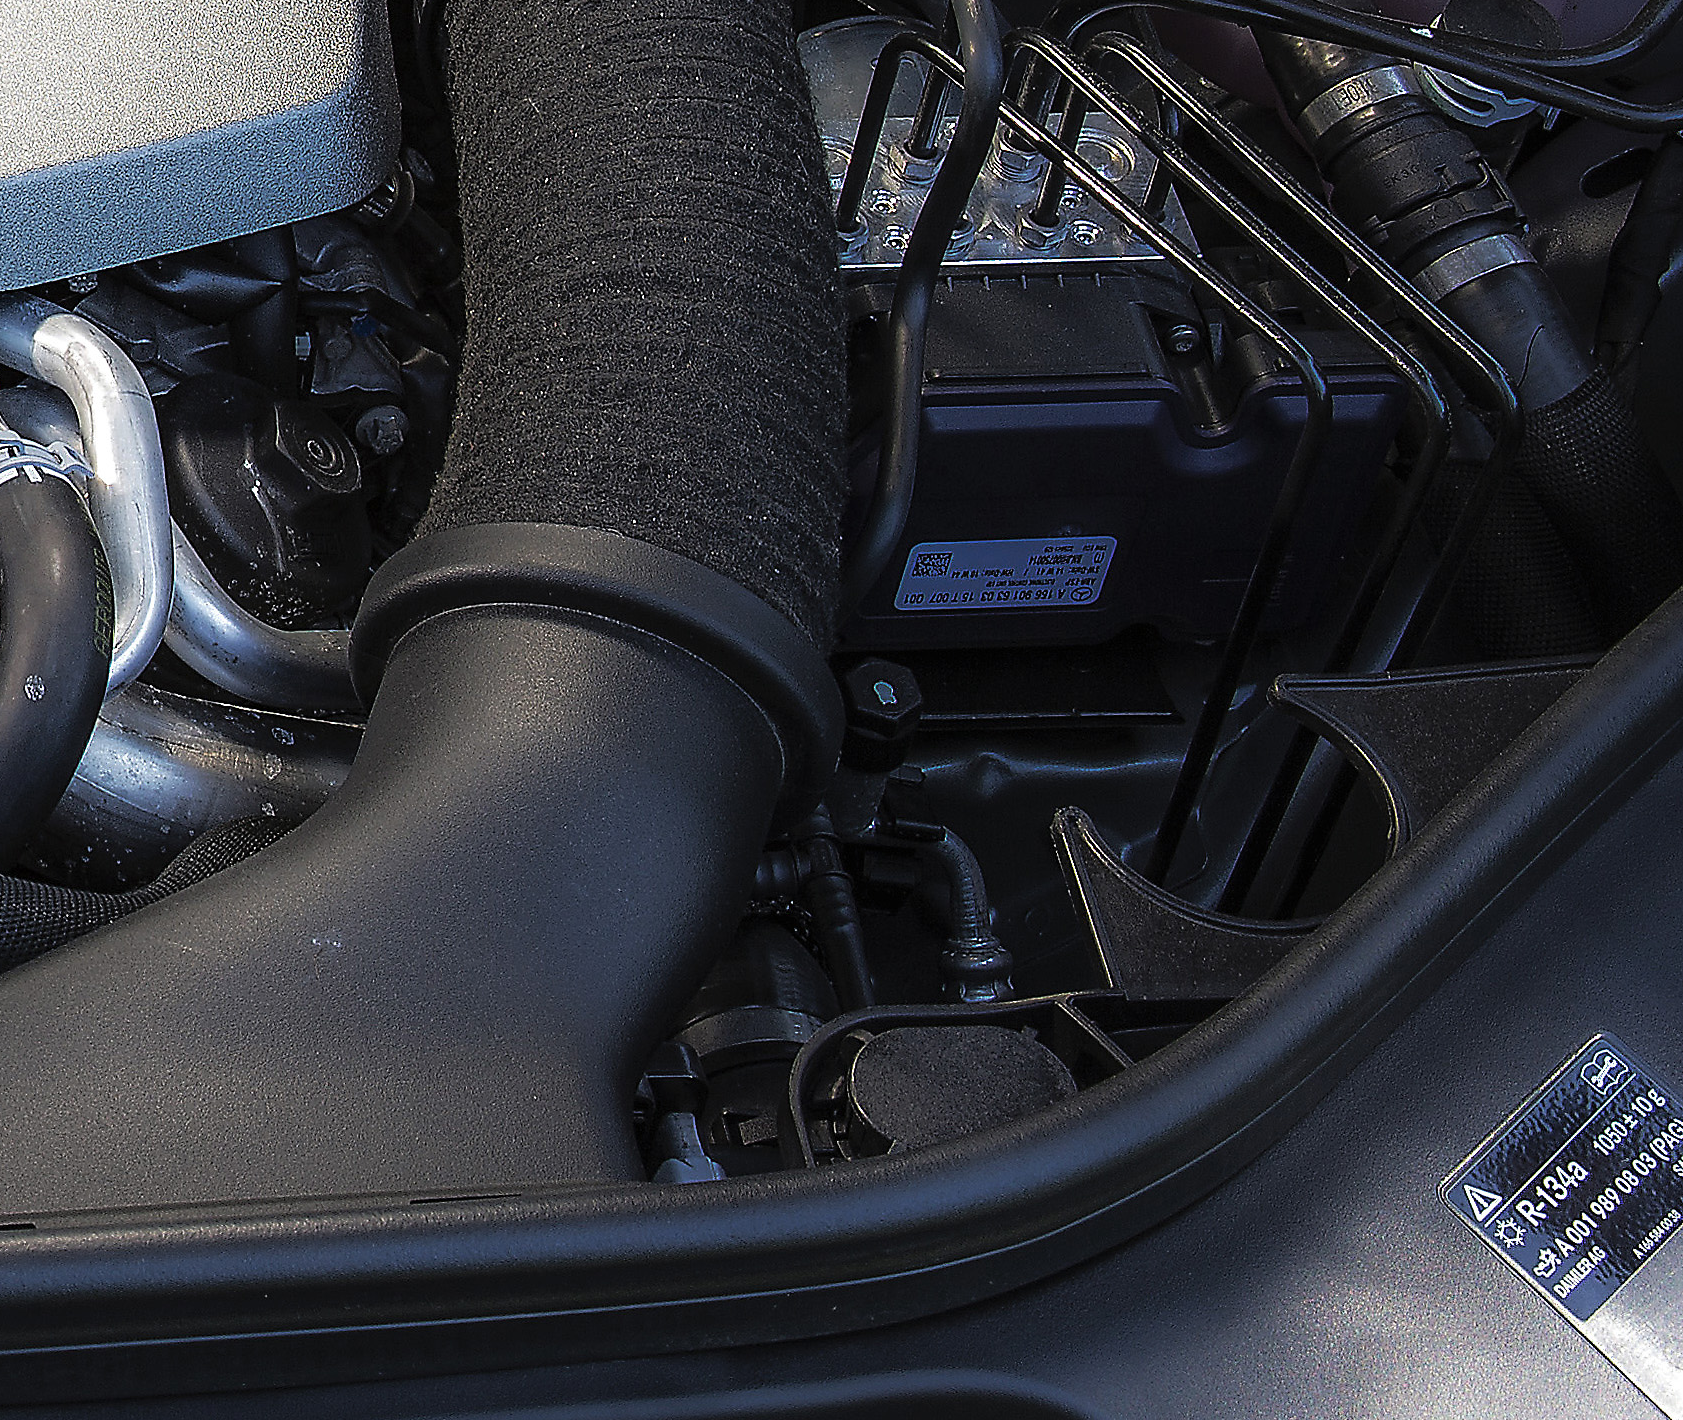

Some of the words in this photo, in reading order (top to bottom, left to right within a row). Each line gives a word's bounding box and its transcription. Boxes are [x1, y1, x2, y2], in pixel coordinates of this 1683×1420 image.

[928, 593, 949, 604] 007
[950, 592, 959, 603] T
[1013, 590, 1033, 600] 901
[1058, 588, 1066, 599] A
[1515, 1160, 1589, 1227] R-134a
[1554, 1237, 1576, 1259] A
[1565, 1212, 1599, 1245] 001
[1589, 1186, 1622, 1220] 989
[1614, 1169, 1640, 1194] 08
[1631, 1151, 1658, 1177] 03
[1632, 1248, 1645, 1261] A
[1552, 1256, 1596, 1300] DAIMLER
[1587, 1245, 1608, 1267] AG
